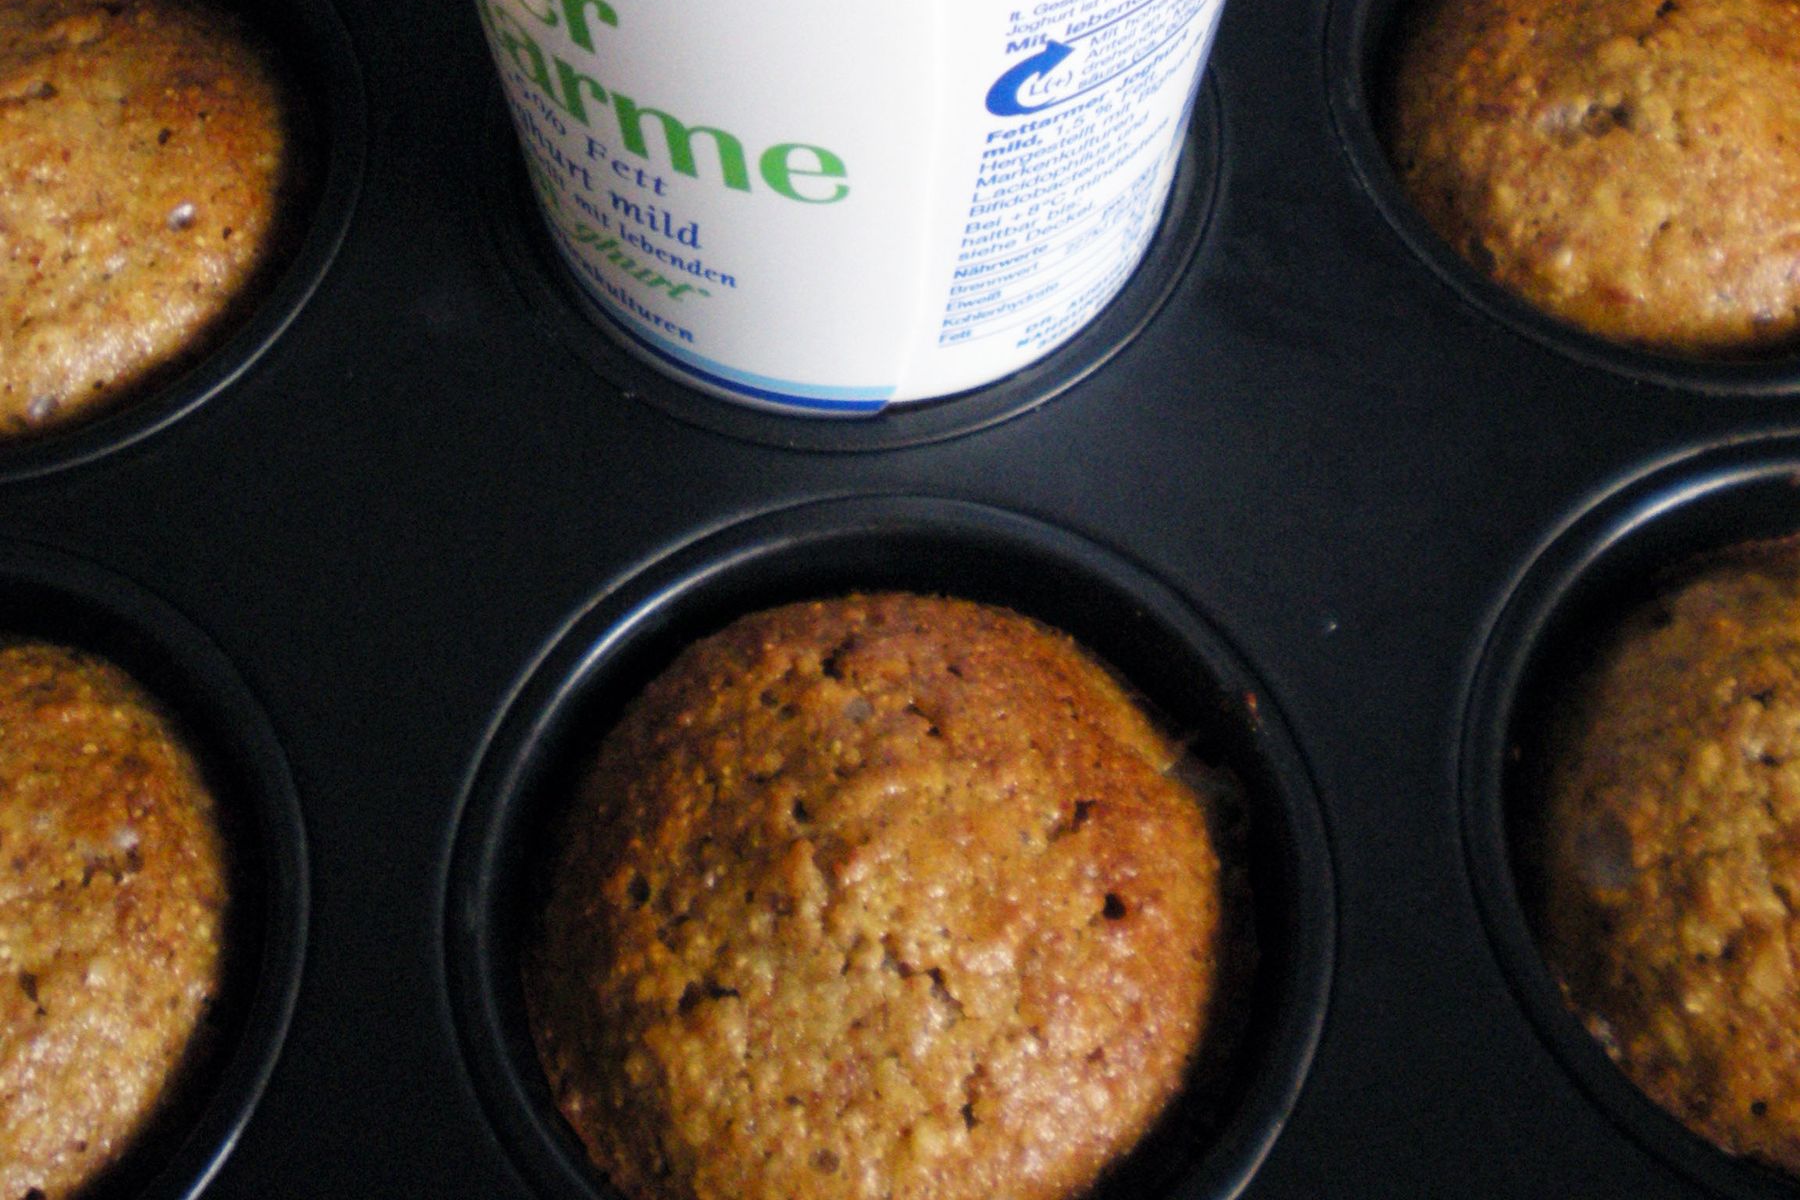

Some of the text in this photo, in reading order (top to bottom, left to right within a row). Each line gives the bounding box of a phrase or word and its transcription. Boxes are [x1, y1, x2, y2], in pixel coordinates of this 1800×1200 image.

[1004, 31, 1050, 56] Mit
[1006, 3, 1075, 37] Joghurt
[492, 3, 849, 206] arme
[986, 90, 1110, 144] Fettarmer
[583, 133, 669, 197] Fett
[609, 190, 703, 250] mild
[619, 222, 738, 289] lebenden
